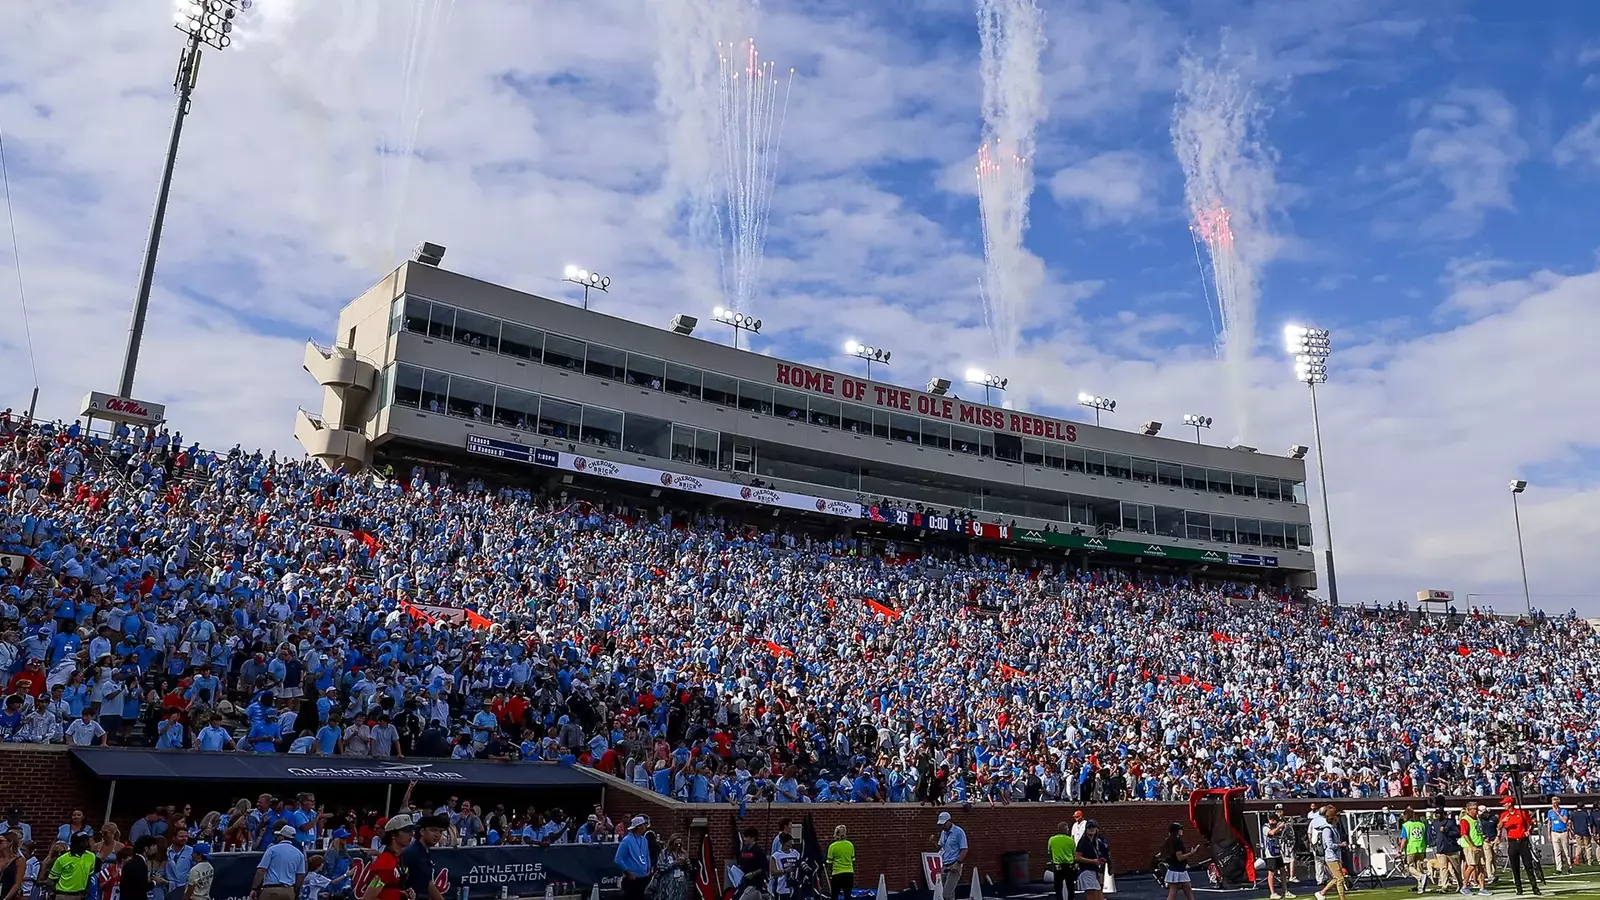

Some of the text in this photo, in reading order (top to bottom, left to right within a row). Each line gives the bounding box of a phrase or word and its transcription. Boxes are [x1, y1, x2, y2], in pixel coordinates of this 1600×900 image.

[106, 398, 148, 416] Ole Miss
[777, 363, 1077, 442] HOME OF THE OLE MISS REBELS
[587, 460, 620, 474] CHEROKEE
[593, 467, 613, 475] BRICK
[673, 475, 703, 489] CHEROKEE
[752, 489, 781, 501] CHEROKEE
[827, 501, 853, 513] CHEROKEE
[896, 510, 908, 525] 26
[929, 516, 949, 531] 0:00
[998, 526, 1008, 539] 14
[469, 863, 542, 874] ATHLETICS
[461, 871, 547, 884] FOUNDATION
